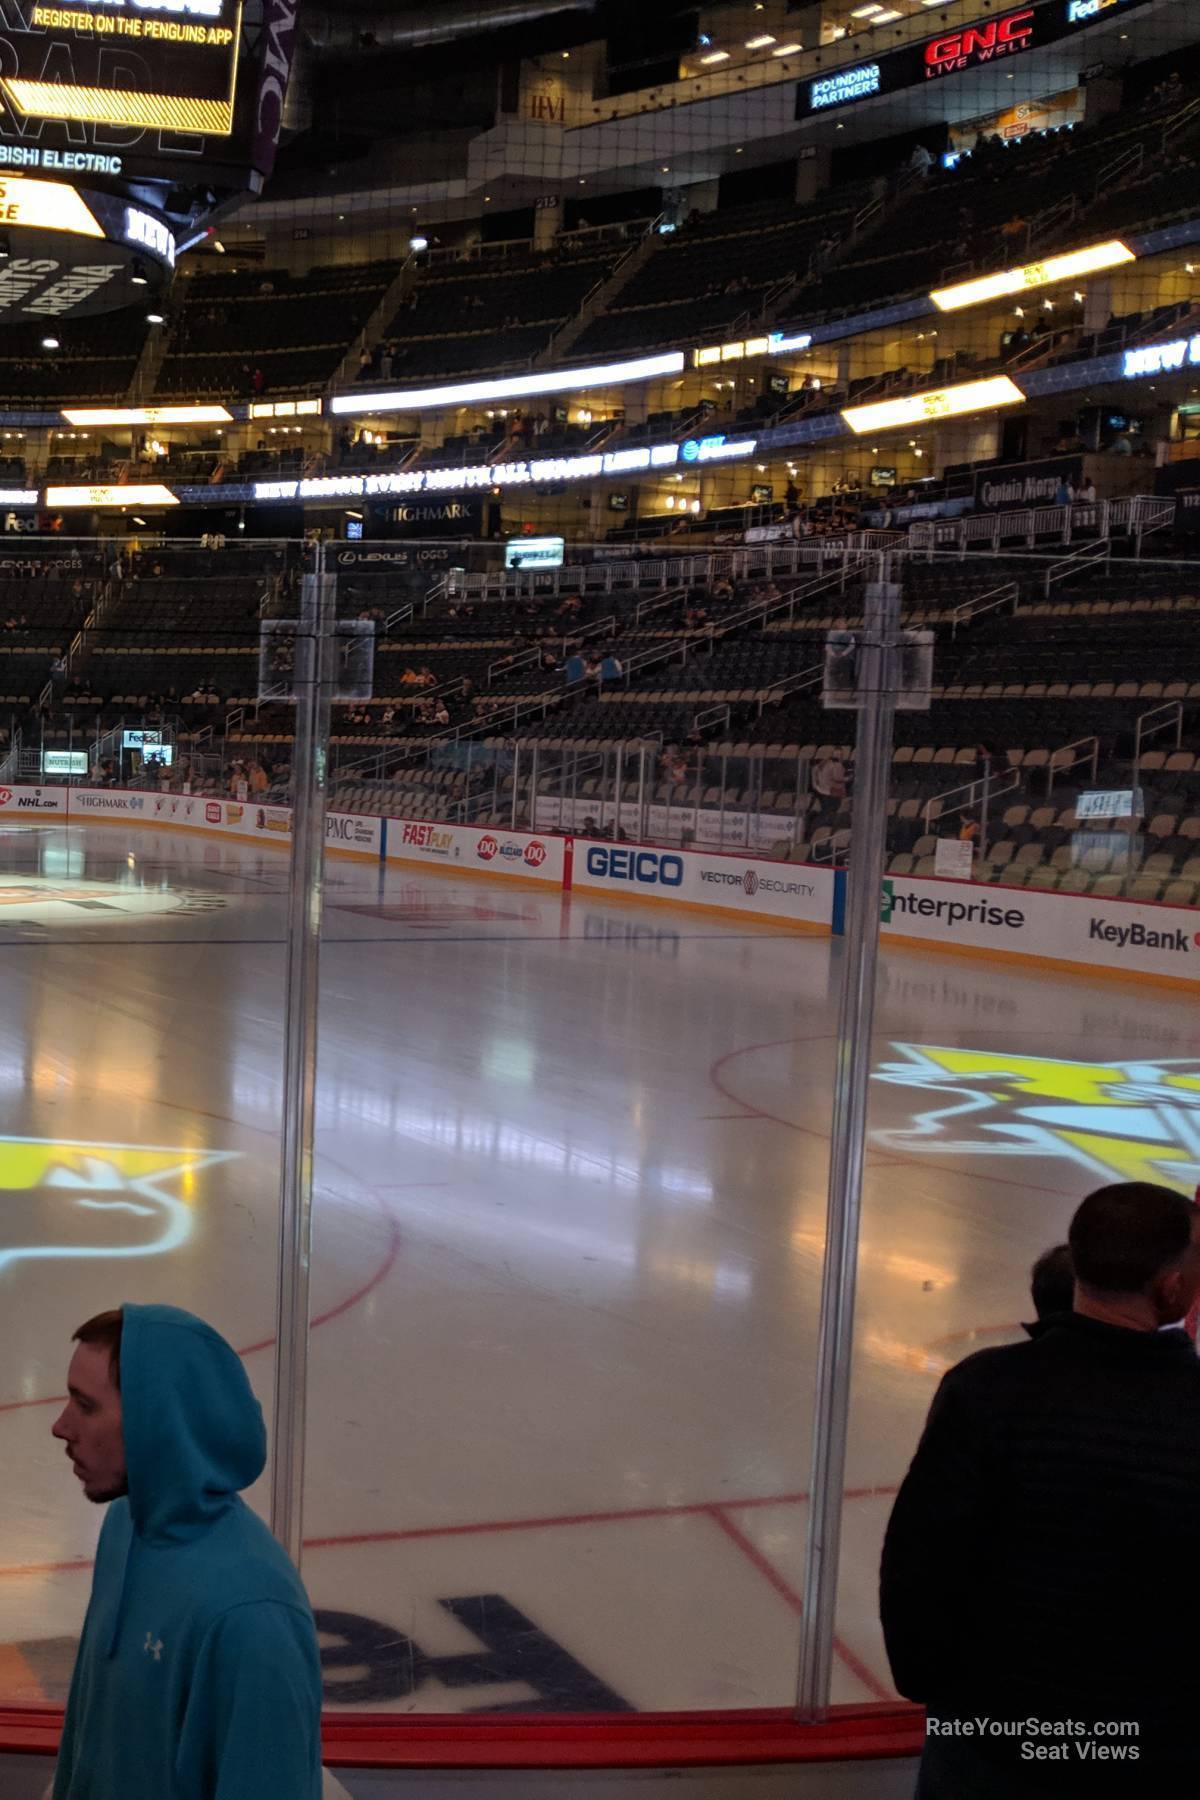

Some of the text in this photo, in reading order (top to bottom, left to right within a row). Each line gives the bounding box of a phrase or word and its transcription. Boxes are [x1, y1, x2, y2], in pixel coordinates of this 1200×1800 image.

[34, 8, 233, 45] REGISTER ON THE PENGUINS APP
[924, 11, 1034, 66] GNC
[926, 37, 1031, 78] LIVE WELL
[812, 65, 880, 95] FOUNDING
[812, 78, 879, 109] PARTNERS
[43, 149, 122, 175] ELECTRIC
[22, 264, 126, 316] ARENA
[4, 512, 63, 532] FedEx
[385, 502, 472, 523] HIGHMARK
[81, 796, 129, 810] HIGHMARK
[324, 816, 353, 841] PMC
[402, 823, 454, 849] FAST PLAY
[586, 846, 684, 887] GEICO
[700, 870, 816, 897] VECTOR SECURITY
[1089, 917, 1190, 952] KeyBank
